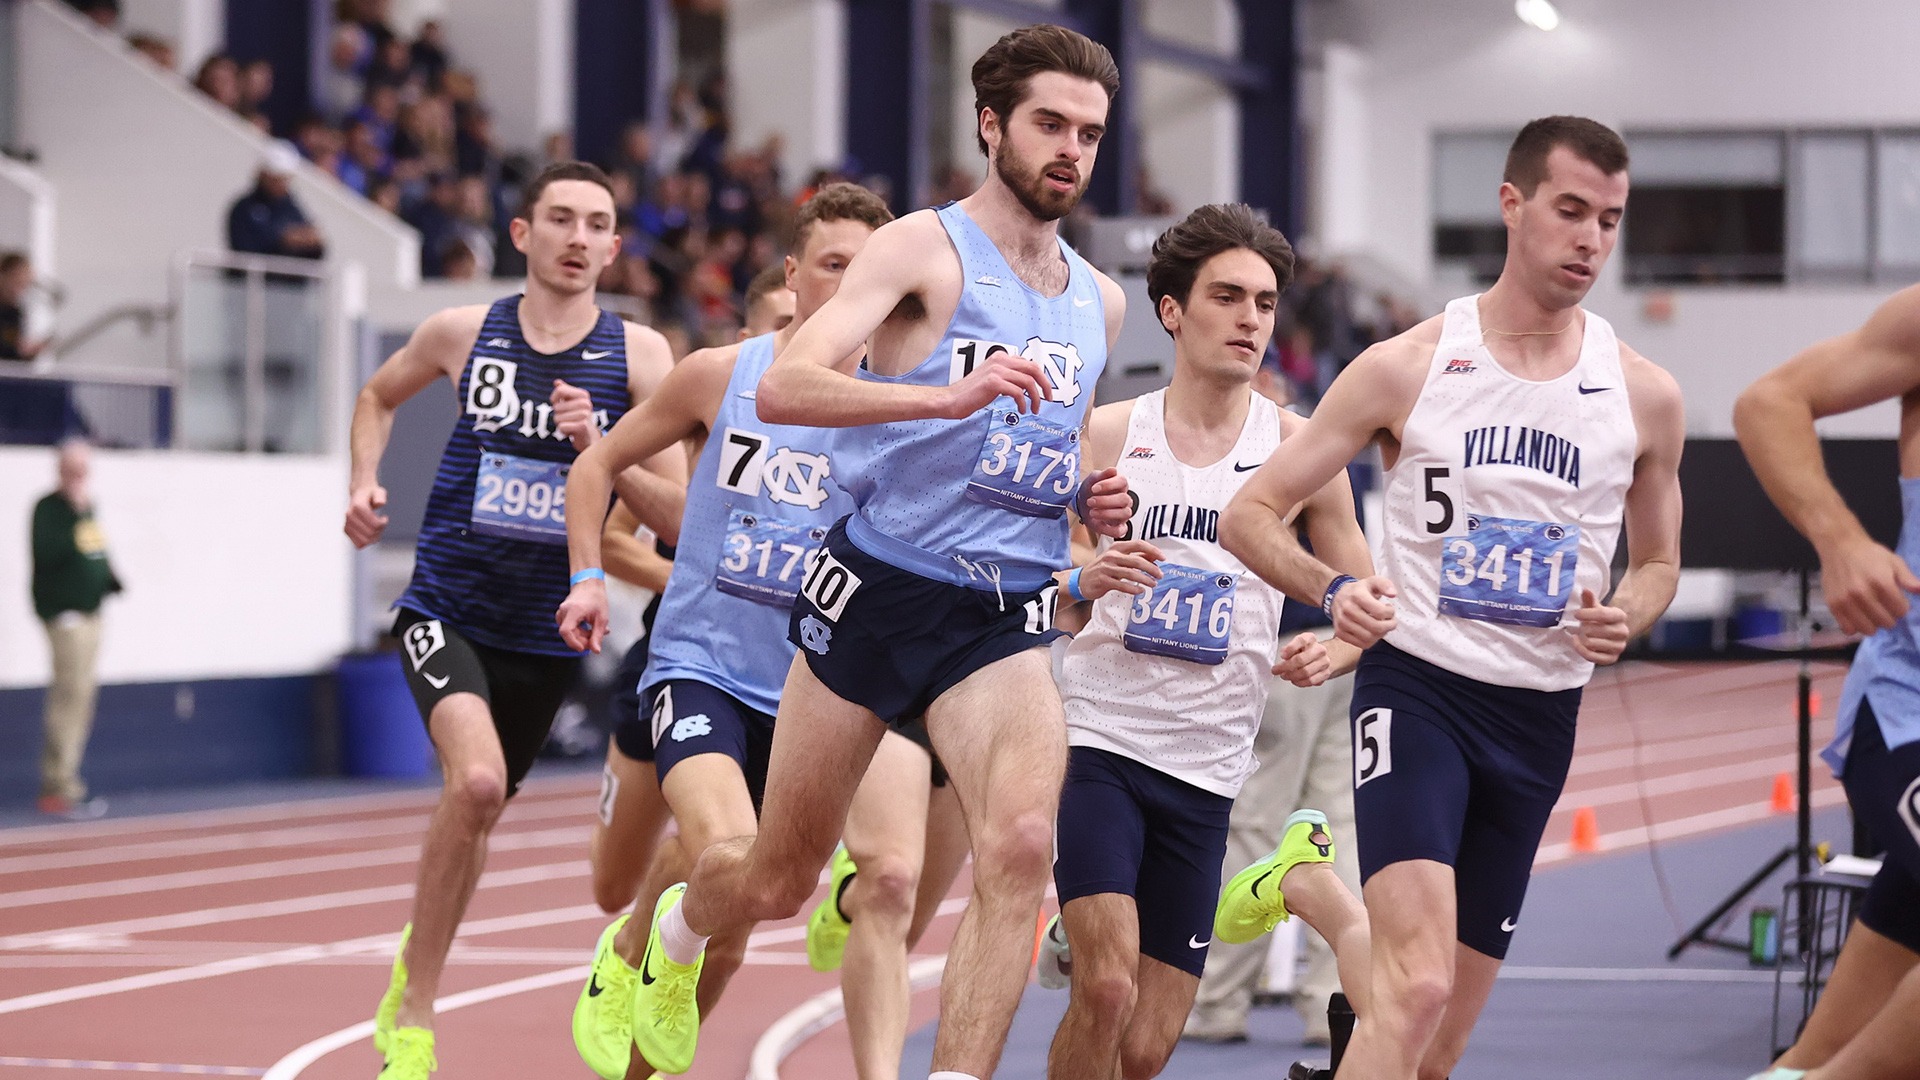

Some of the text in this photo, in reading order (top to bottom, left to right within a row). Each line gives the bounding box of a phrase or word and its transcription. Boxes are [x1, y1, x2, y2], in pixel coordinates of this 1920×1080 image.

[957, 341, 1009, 378] 1
[1449, 359, 1472, 367] BIG
[474, 364, 504, 409] 8
[1028, 421, 1065, 438] PENN STATE
[727, 433, 762, 487] 7
[981, 433, 1076, 495] 3173
[1464, 426, 1580, 488] VILLANOVA
[1000, 489, 1041, 506] NITTANY LIONS
[1424, 468, 1455, 534] 5
[804, 553, 848, 611] 10
[1169, 569, 1206, 581] PENN STATE
[1445, 539, 1564, 597] 3411
[1131, 584, 1232, 638] 3416
[1478, 599, 1531, 612] NITTANY LIONS
[410, 625, 435, 661] 8
[1152, 637, 1198, 650] NITTANY LIONS
[1360, 712, 1379, 780] 5
